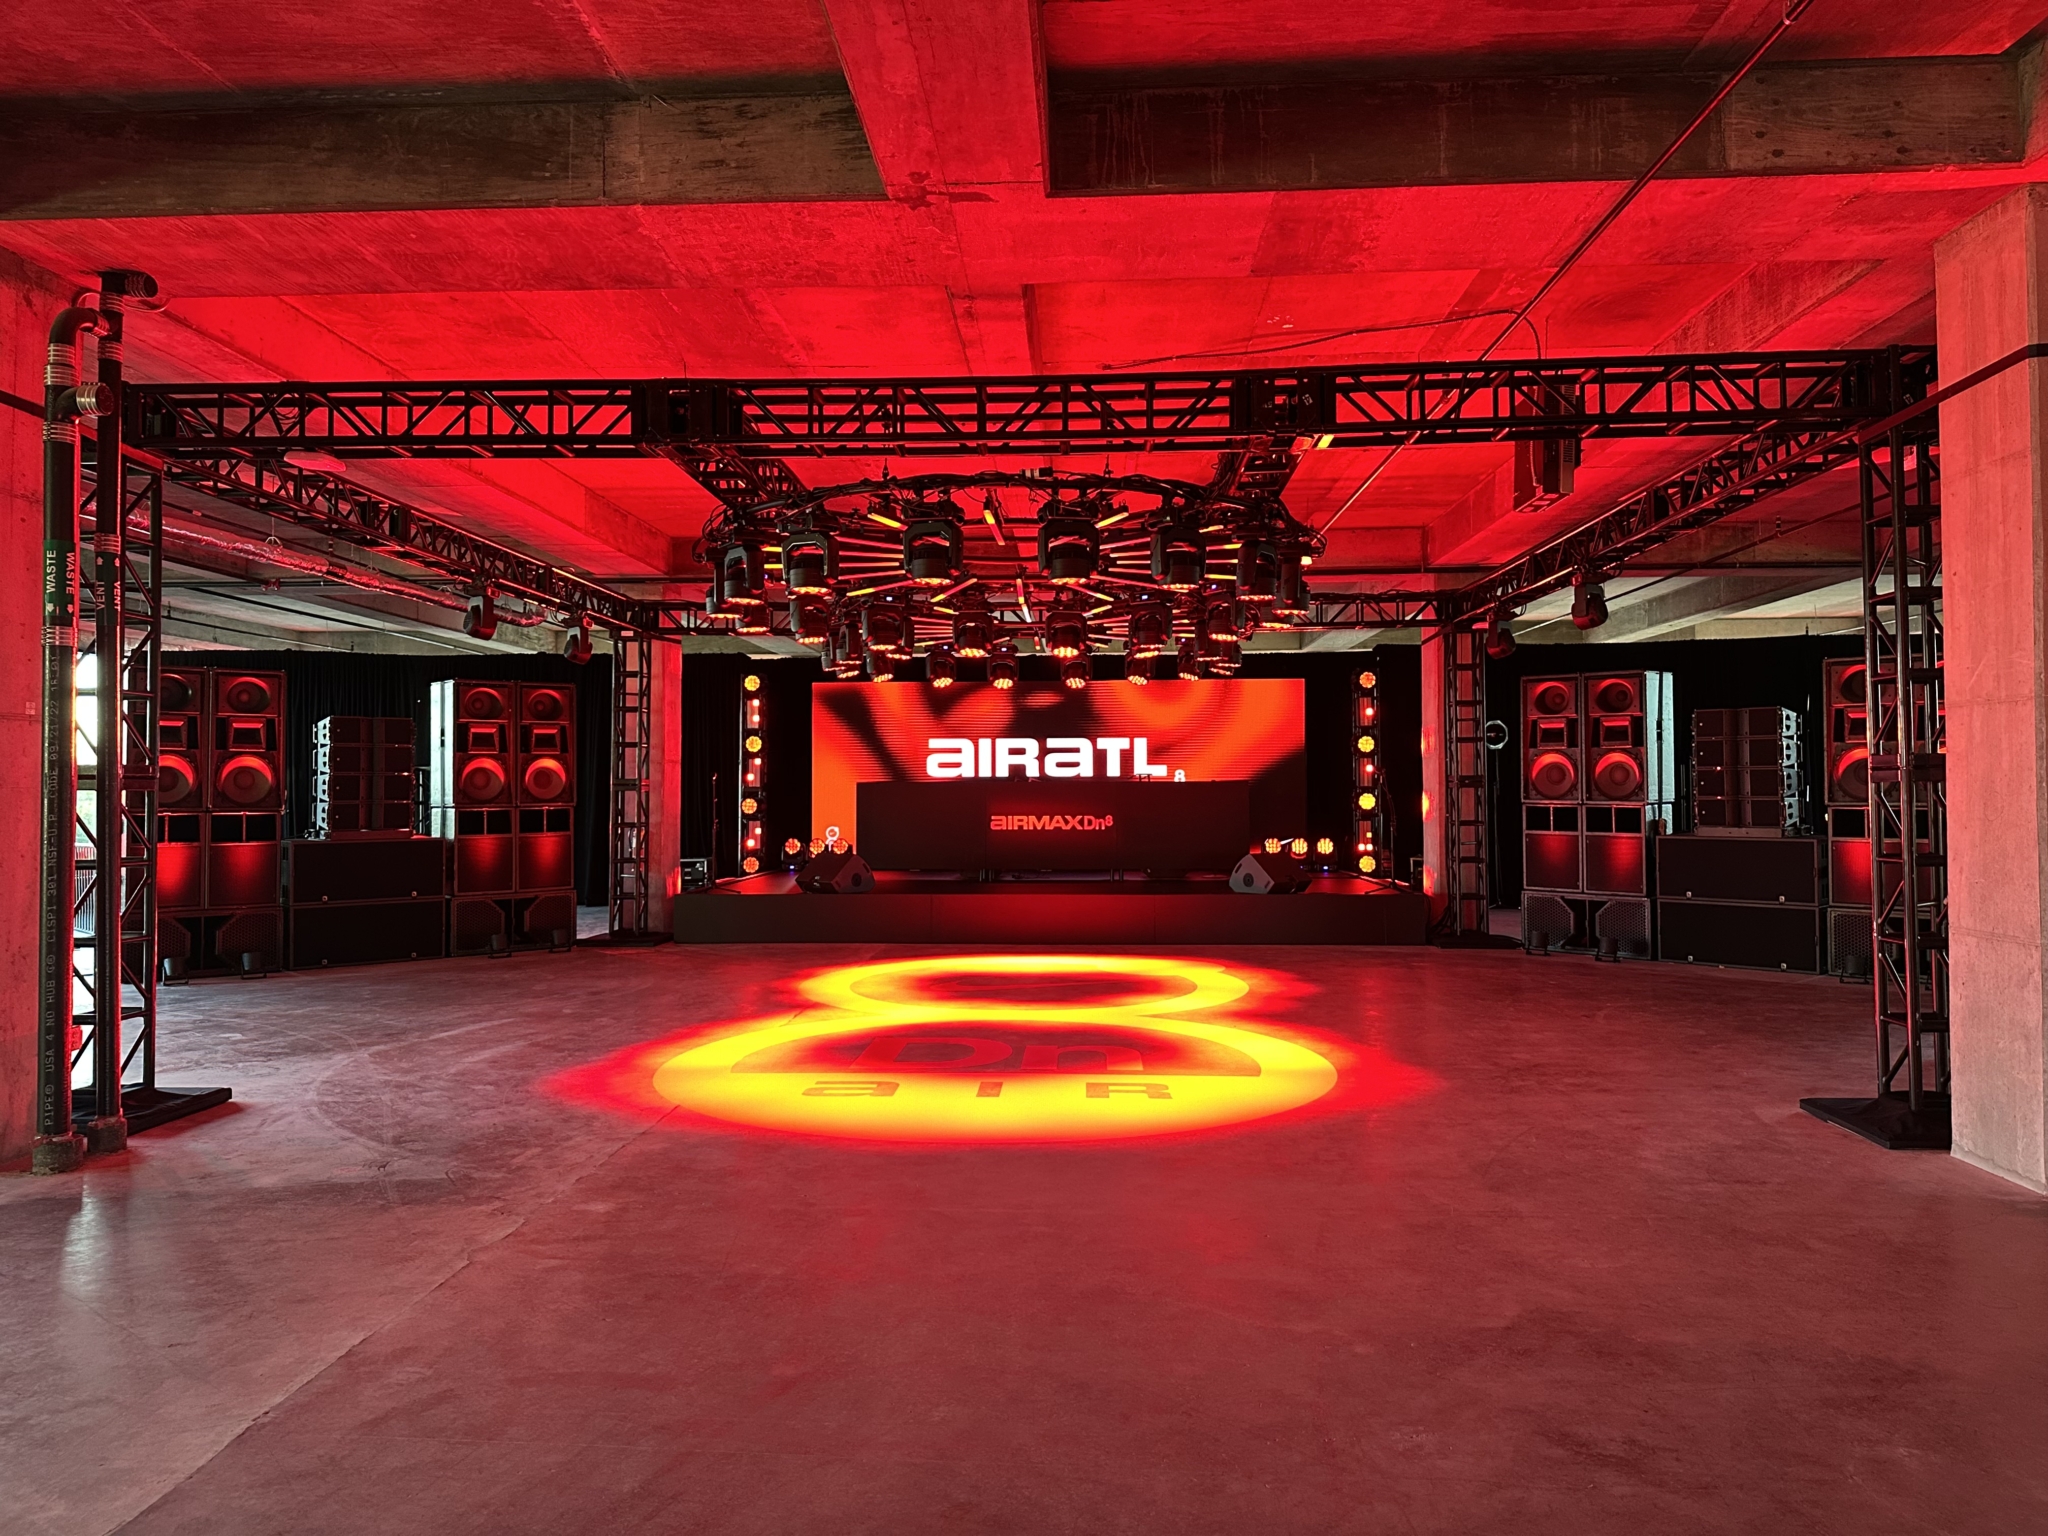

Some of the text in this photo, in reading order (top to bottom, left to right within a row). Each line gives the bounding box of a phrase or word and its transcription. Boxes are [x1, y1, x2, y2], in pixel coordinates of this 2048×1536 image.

[46, 550, 56, 594] WASTE
[66, 552, 75, 595] WASTE
[96, 579, 105, 610] VENT
[47, 873, 57, 897] 301
[46, 979, 55, 1003] HUB
[46, 1010, 55, 1026] NO
[46, 1033, 55, 1041] 4
[45, 1048, 55, 1072] USA
[848, 1036, 1144, 1071] Dn
